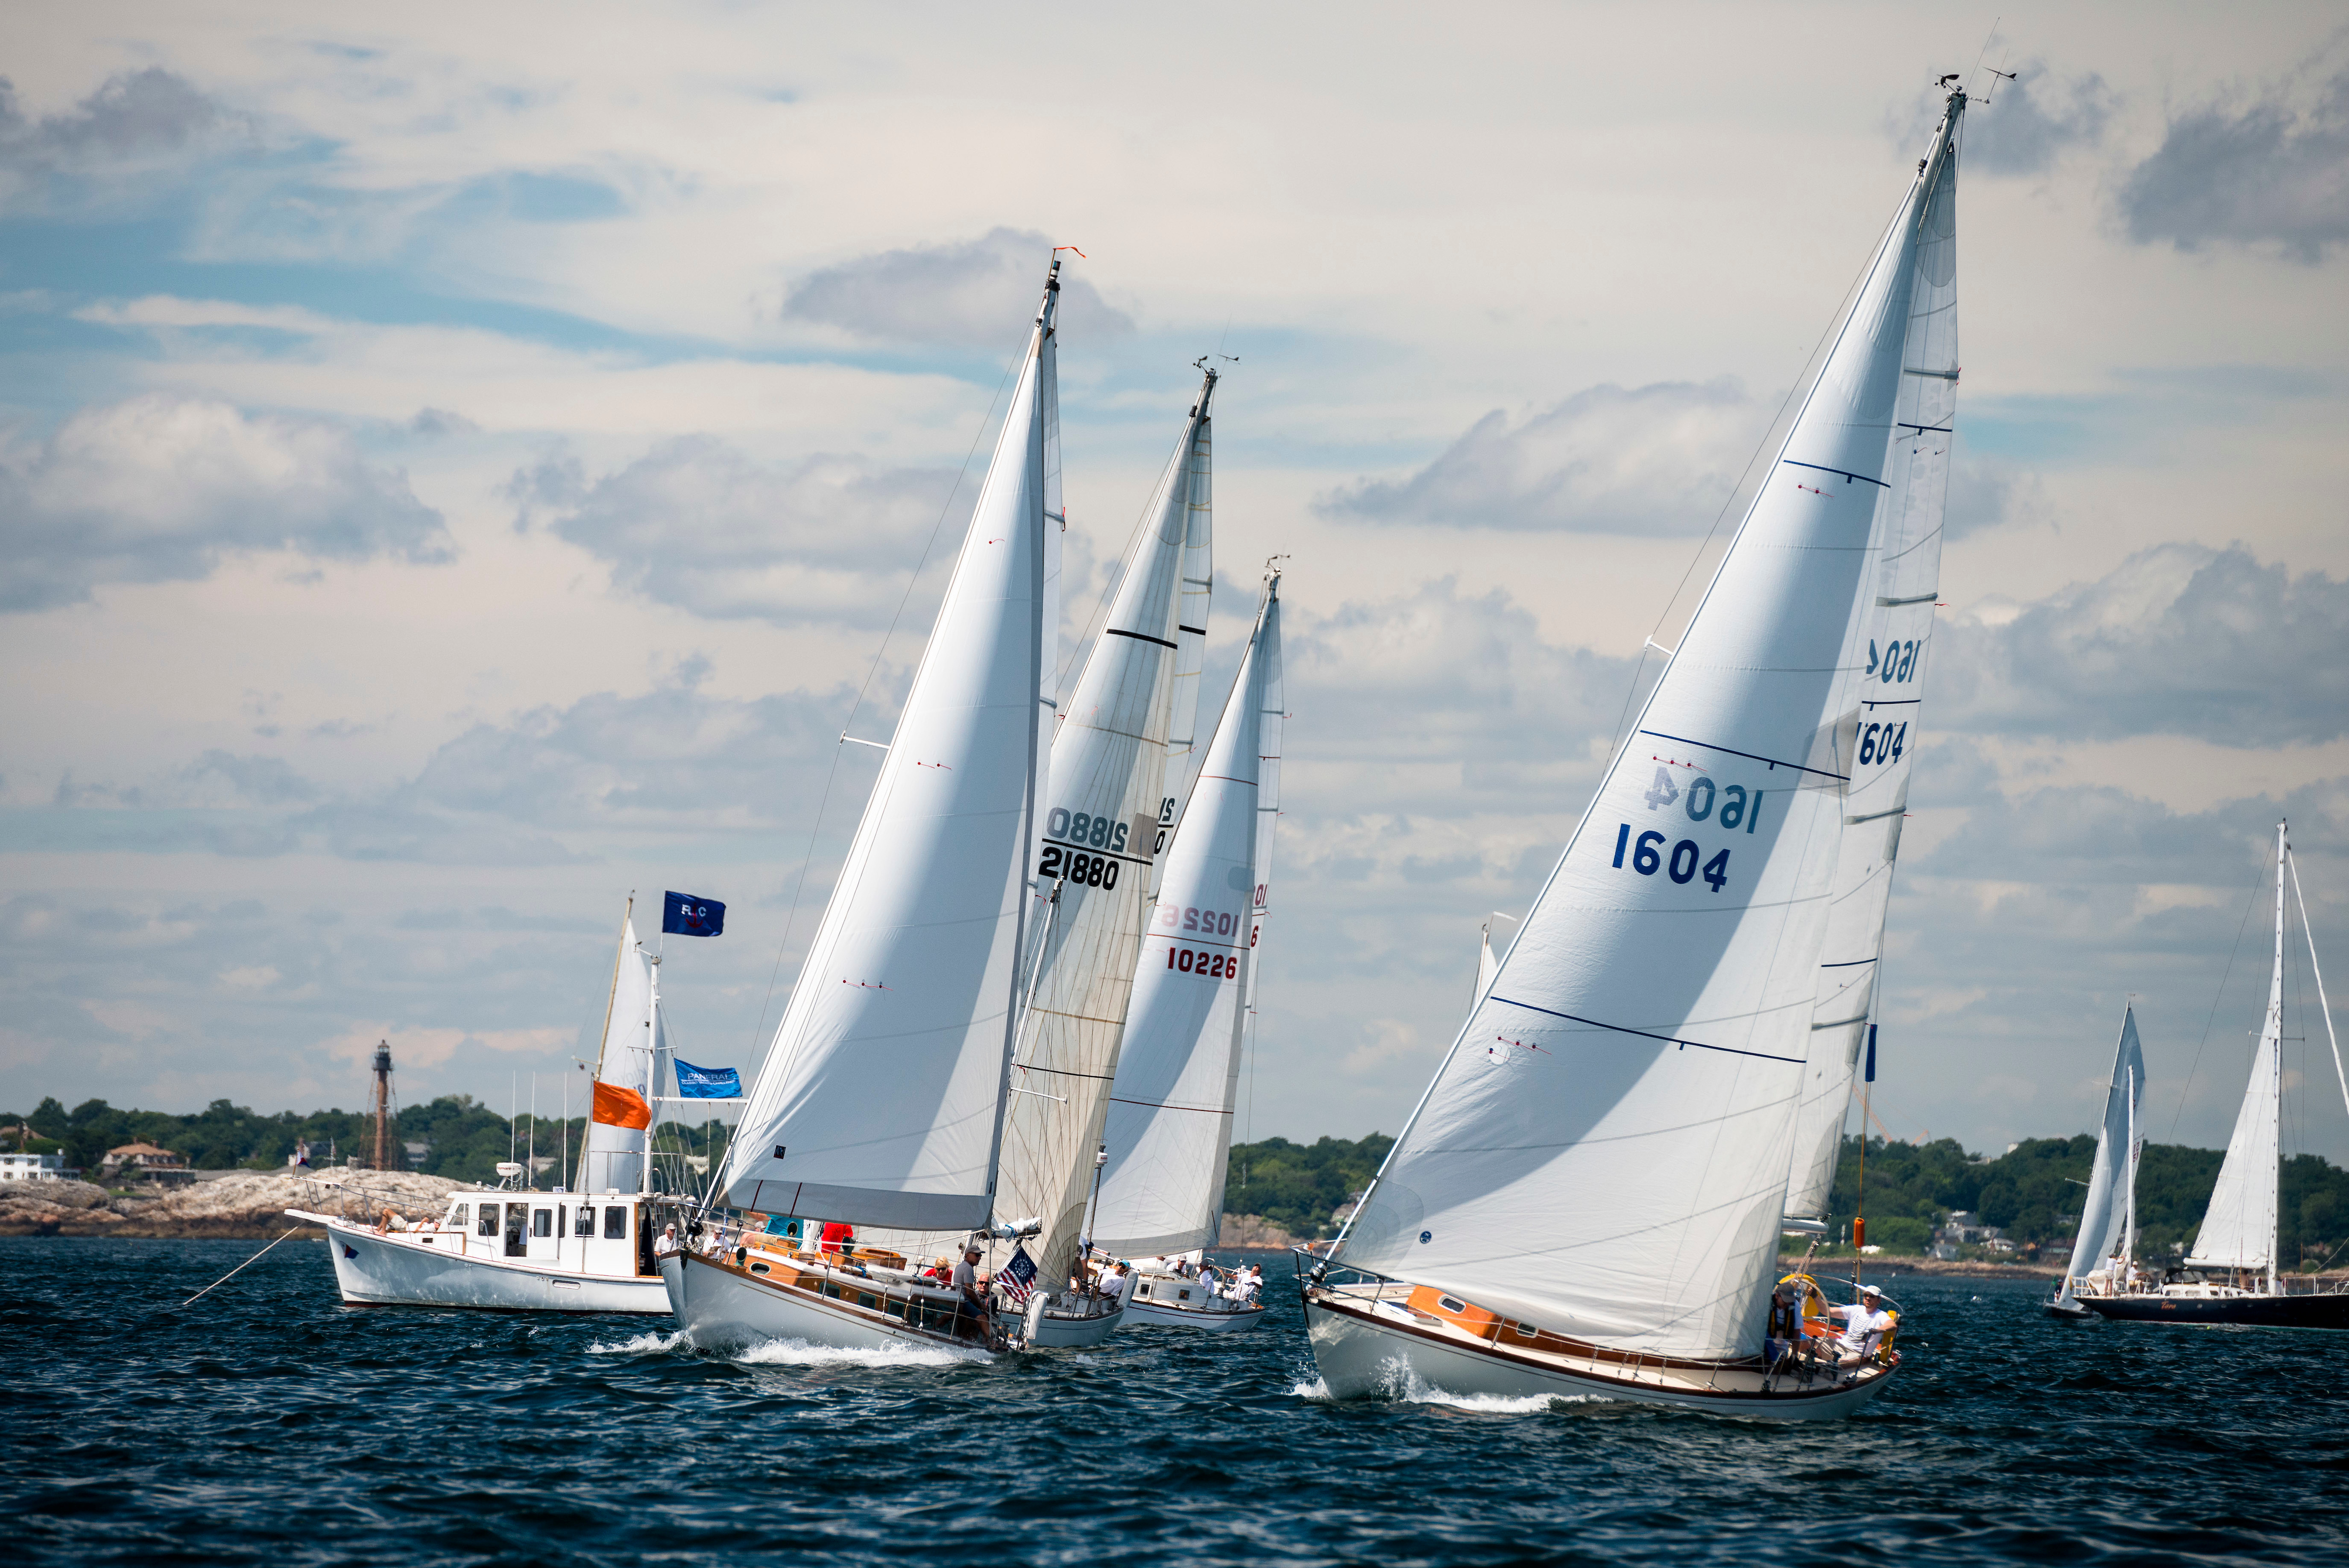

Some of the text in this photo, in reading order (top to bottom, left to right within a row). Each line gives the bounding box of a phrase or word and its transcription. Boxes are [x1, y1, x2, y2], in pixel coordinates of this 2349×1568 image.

[1038, 847, 1119, 891] 21880
[1612, 823, 1731, 893] 1604
[1168, 946, 1237, 979] 10226
